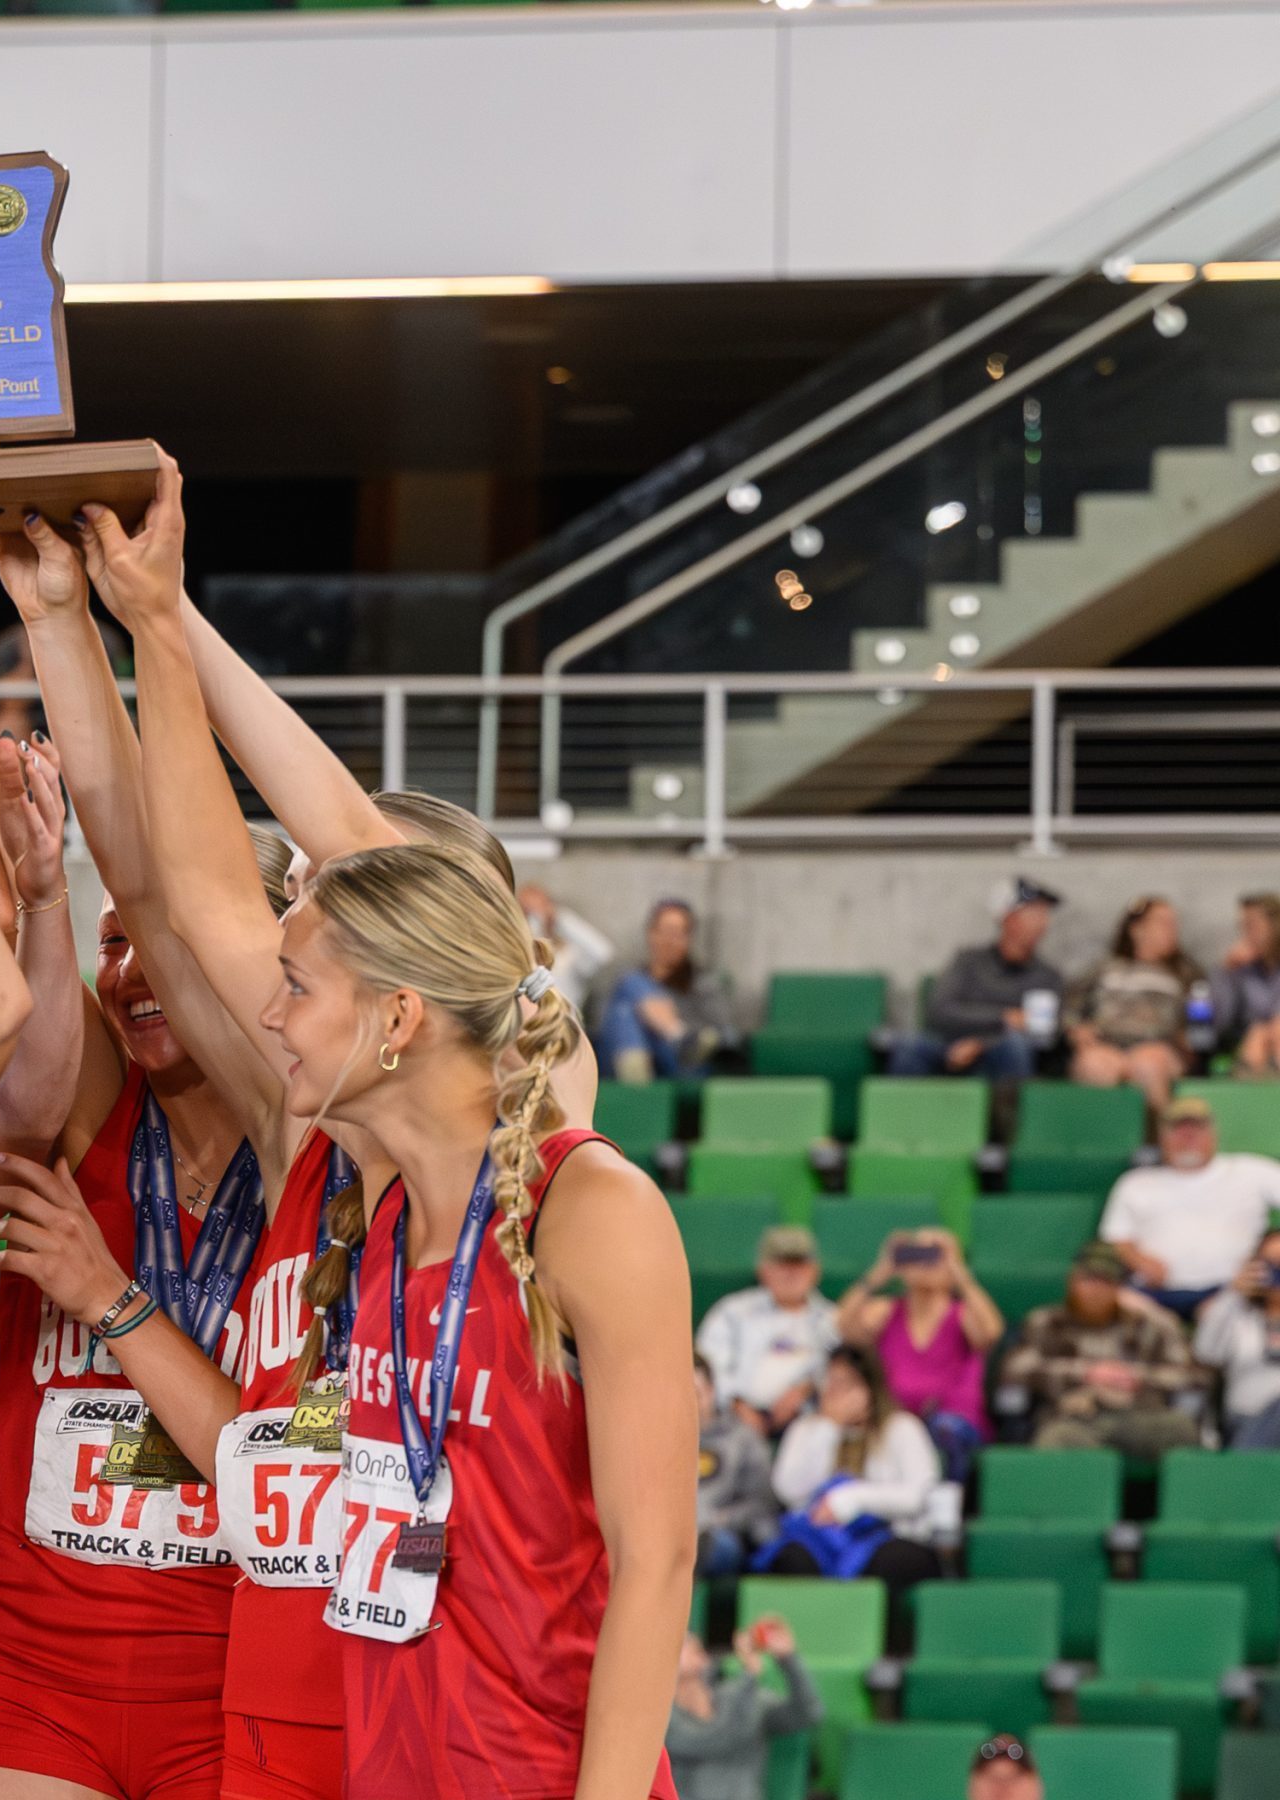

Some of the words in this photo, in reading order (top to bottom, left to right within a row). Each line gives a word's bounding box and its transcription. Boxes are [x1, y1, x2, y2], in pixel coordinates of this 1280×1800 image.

[68, 1401, 141, 1424] OSAA
[292, 1406, 339, 1428] OSA
[248, 1422, 291, 1442] OS
[108, 1442, 142, 1465] OS
[355, 1450, 412, 1483] OnPo
[52, 1530, 130, 1556] TRACK
[137, 1540, 154, 1558] &
[162, 1542, 232, 1566] FIELD
[248, 1555, 307, 1575] TRACK
[315, 1554, 329, 1573] &
[338, 1597, 350, 1617] &
[356, 1601, 406, 1629] FIELD
